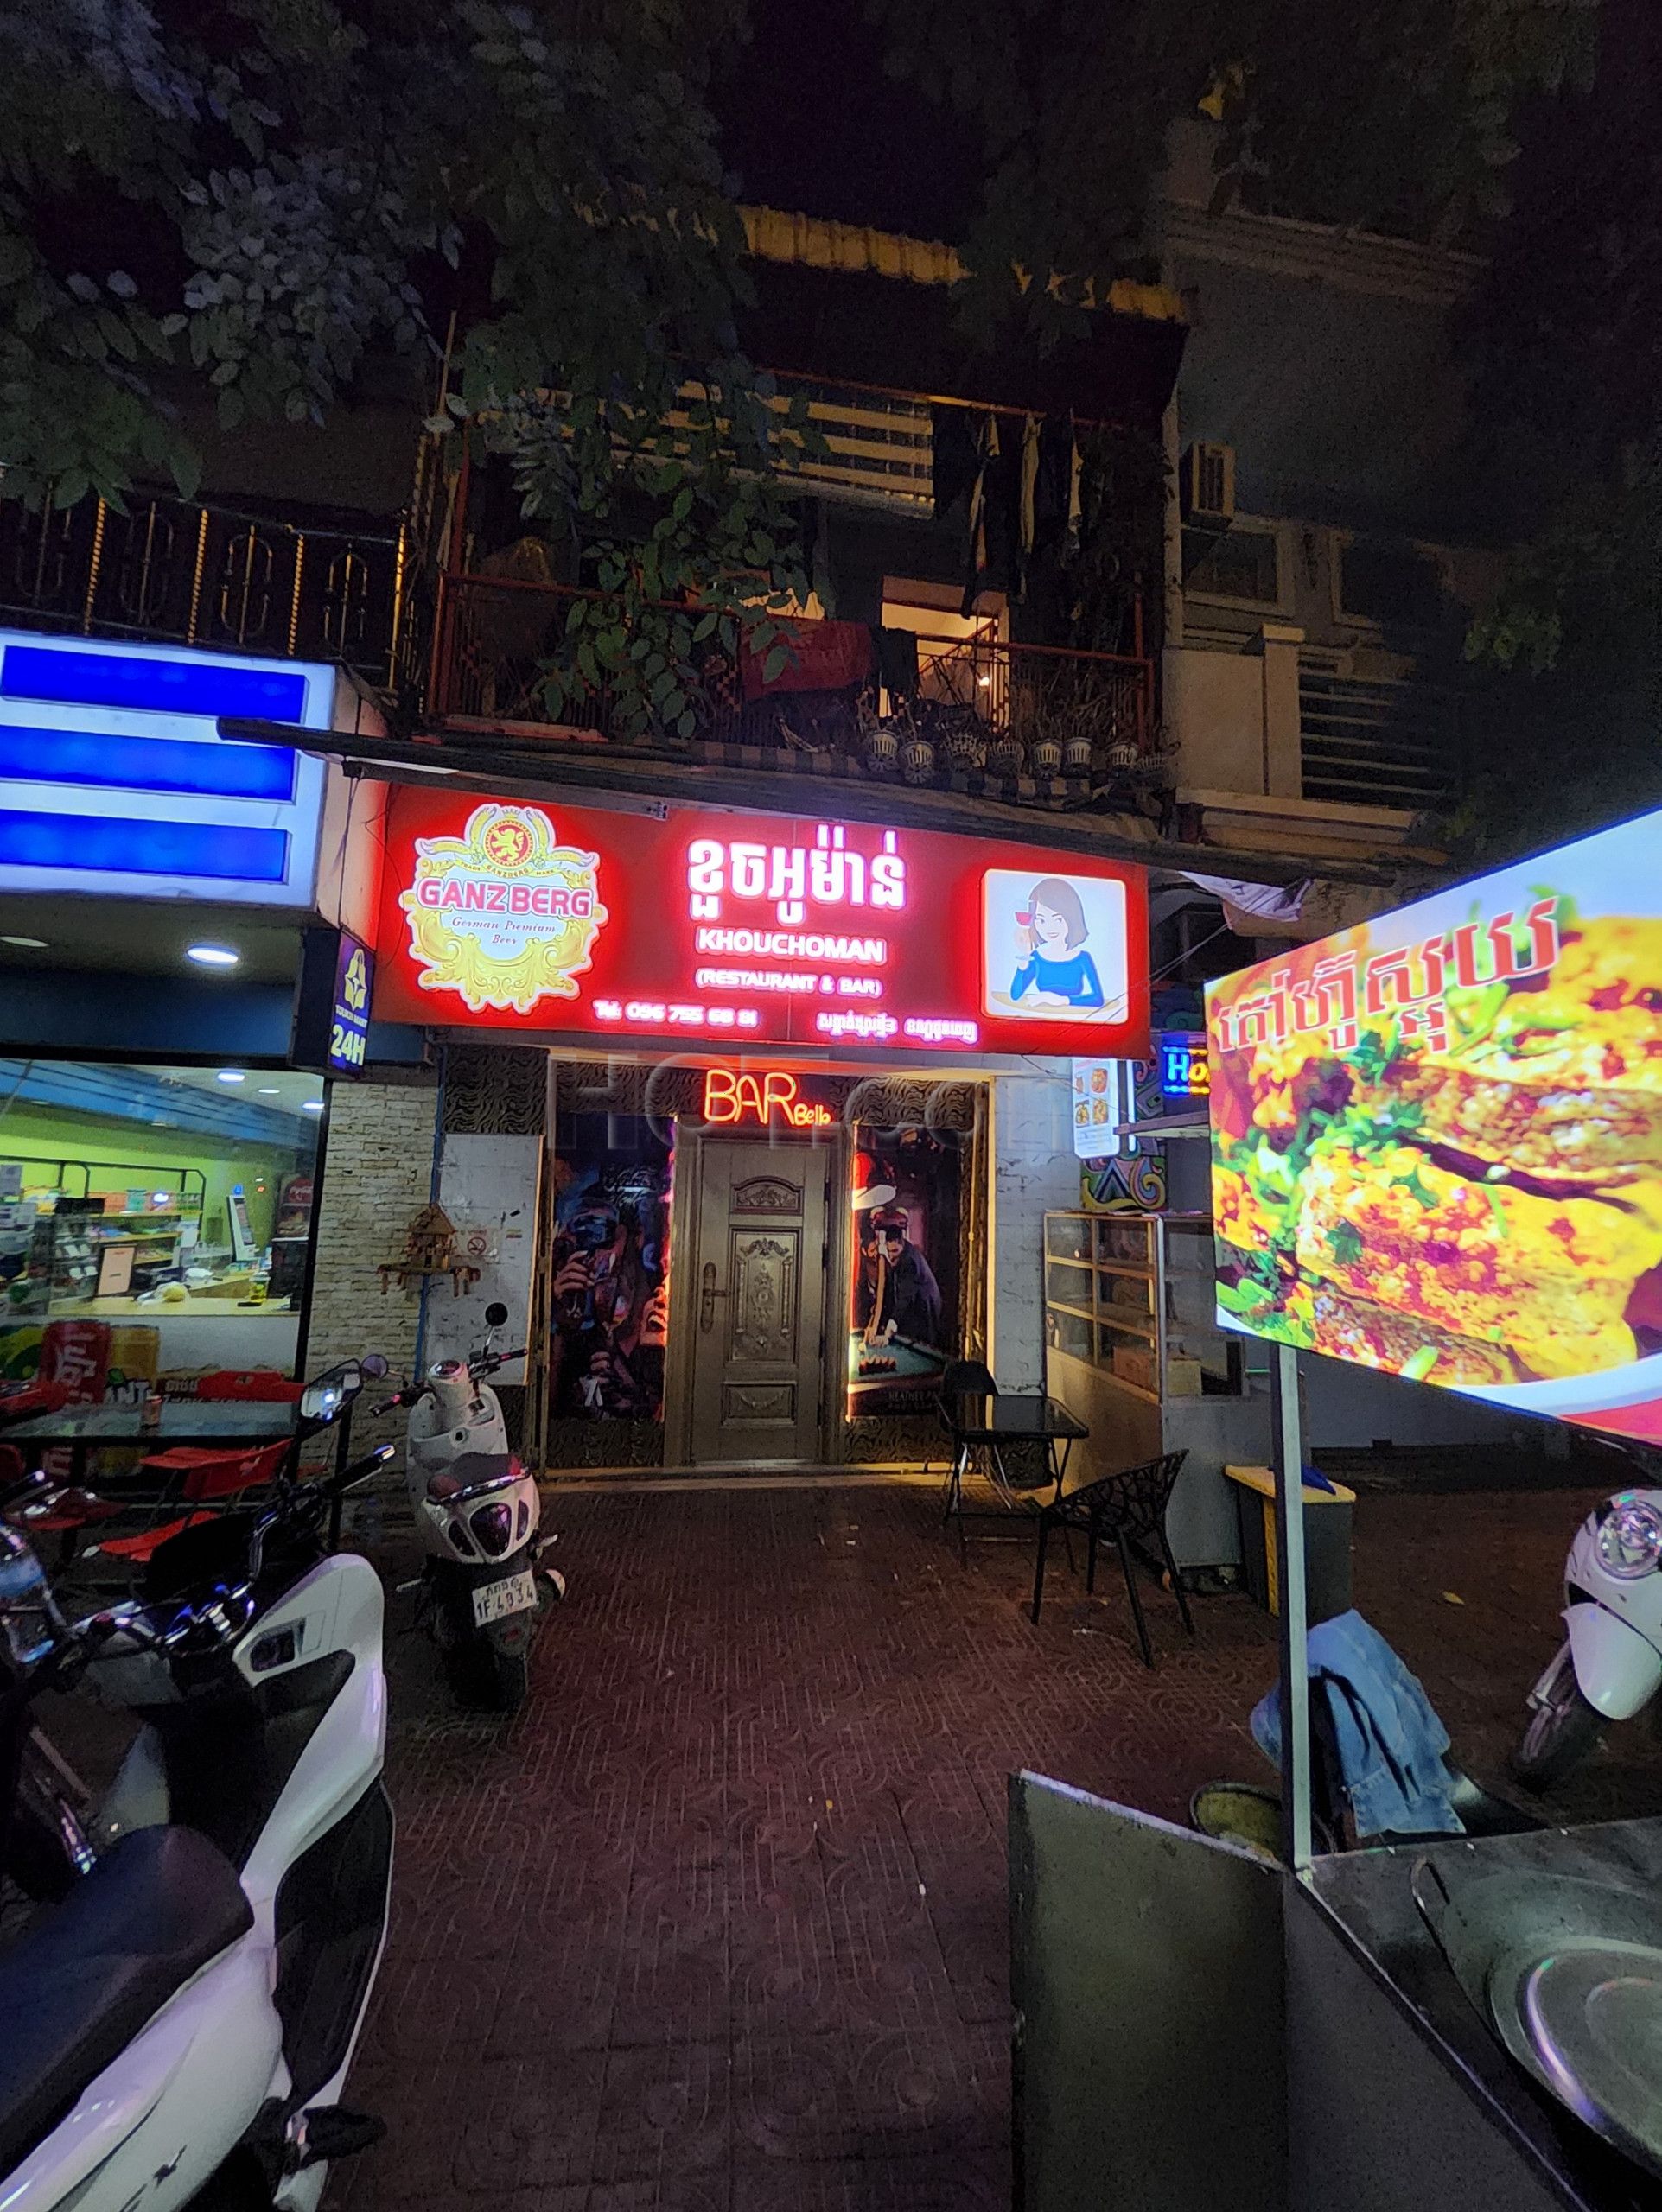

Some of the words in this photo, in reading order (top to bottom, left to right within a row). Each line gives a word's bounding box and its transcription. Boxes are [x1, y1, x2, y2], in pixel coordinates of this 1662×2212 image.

[419, 879, 592, 918] GANZBERG
[451, 917, 499, 929] German
[505, 920, 556, 933] Premium
[491, 935, 518, 944] Beer
[698, 929, 884, 962] KHOUCHOMAN
[696, 970, 816, 992] (RESTAURANT
[820, 976, 835, 992] &
[838, 977, 882, 997] BAR)
[331, 1024, 366, 1066] 24H
[704, 1069, 796, 1124] BAR
